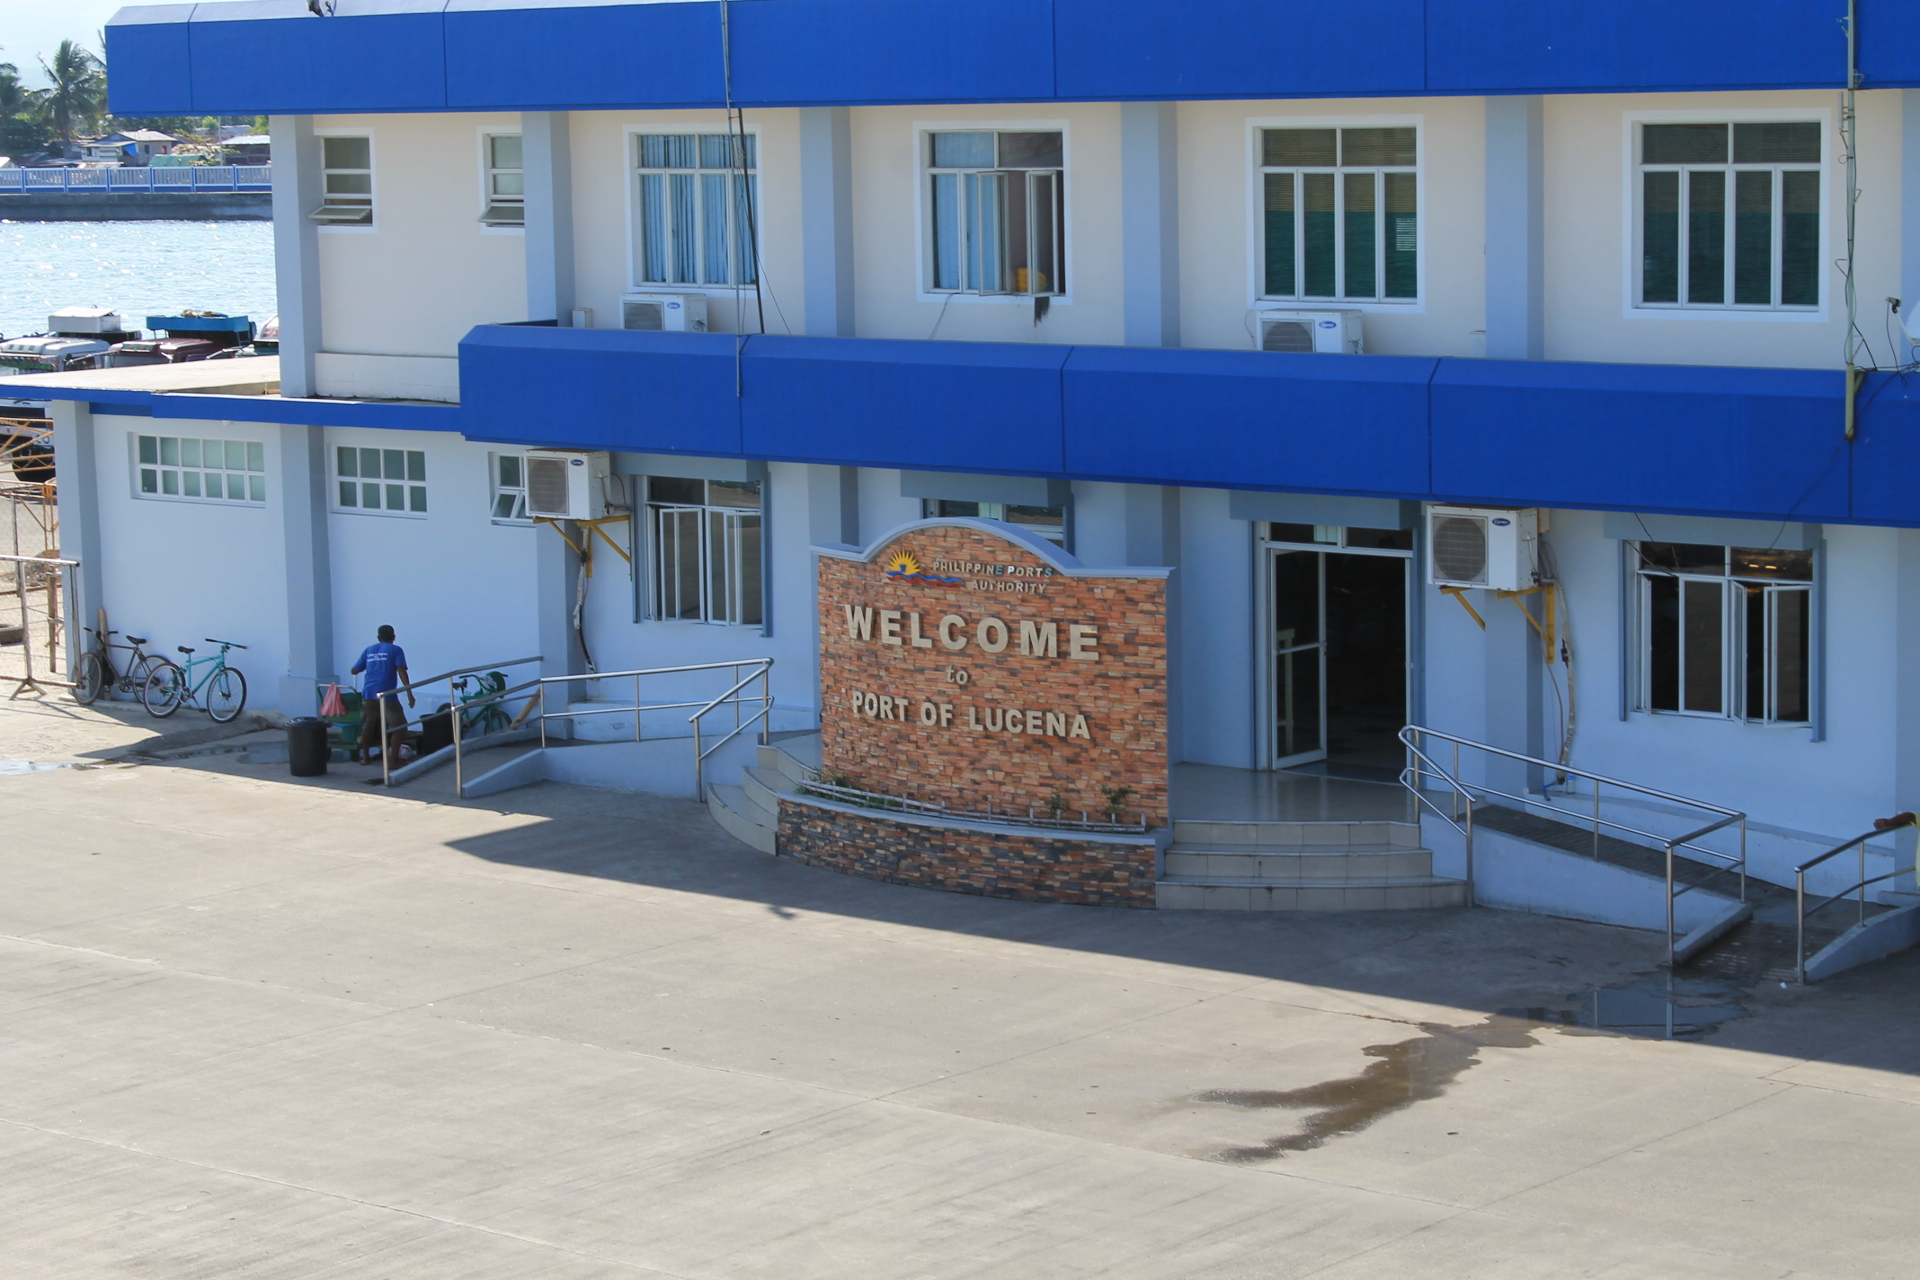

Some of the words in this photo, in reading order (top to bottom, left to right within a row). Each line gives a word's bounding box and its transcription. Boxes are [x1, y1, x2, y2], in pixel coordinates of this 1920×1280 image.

[933, 561, 1003, 576] PHILIPPINE
[1007, 565, 1053, 578] PORTS
[972, 580, 1047, 594] AUTHORITY
[844, 603, 1100, 661] WELCOME
[946, 664, 969, 685] to
[852, 690, 909, 722] PORT
[920, 701, 953, 728] OF
[968, 706, 1091, 740] LUCENA
